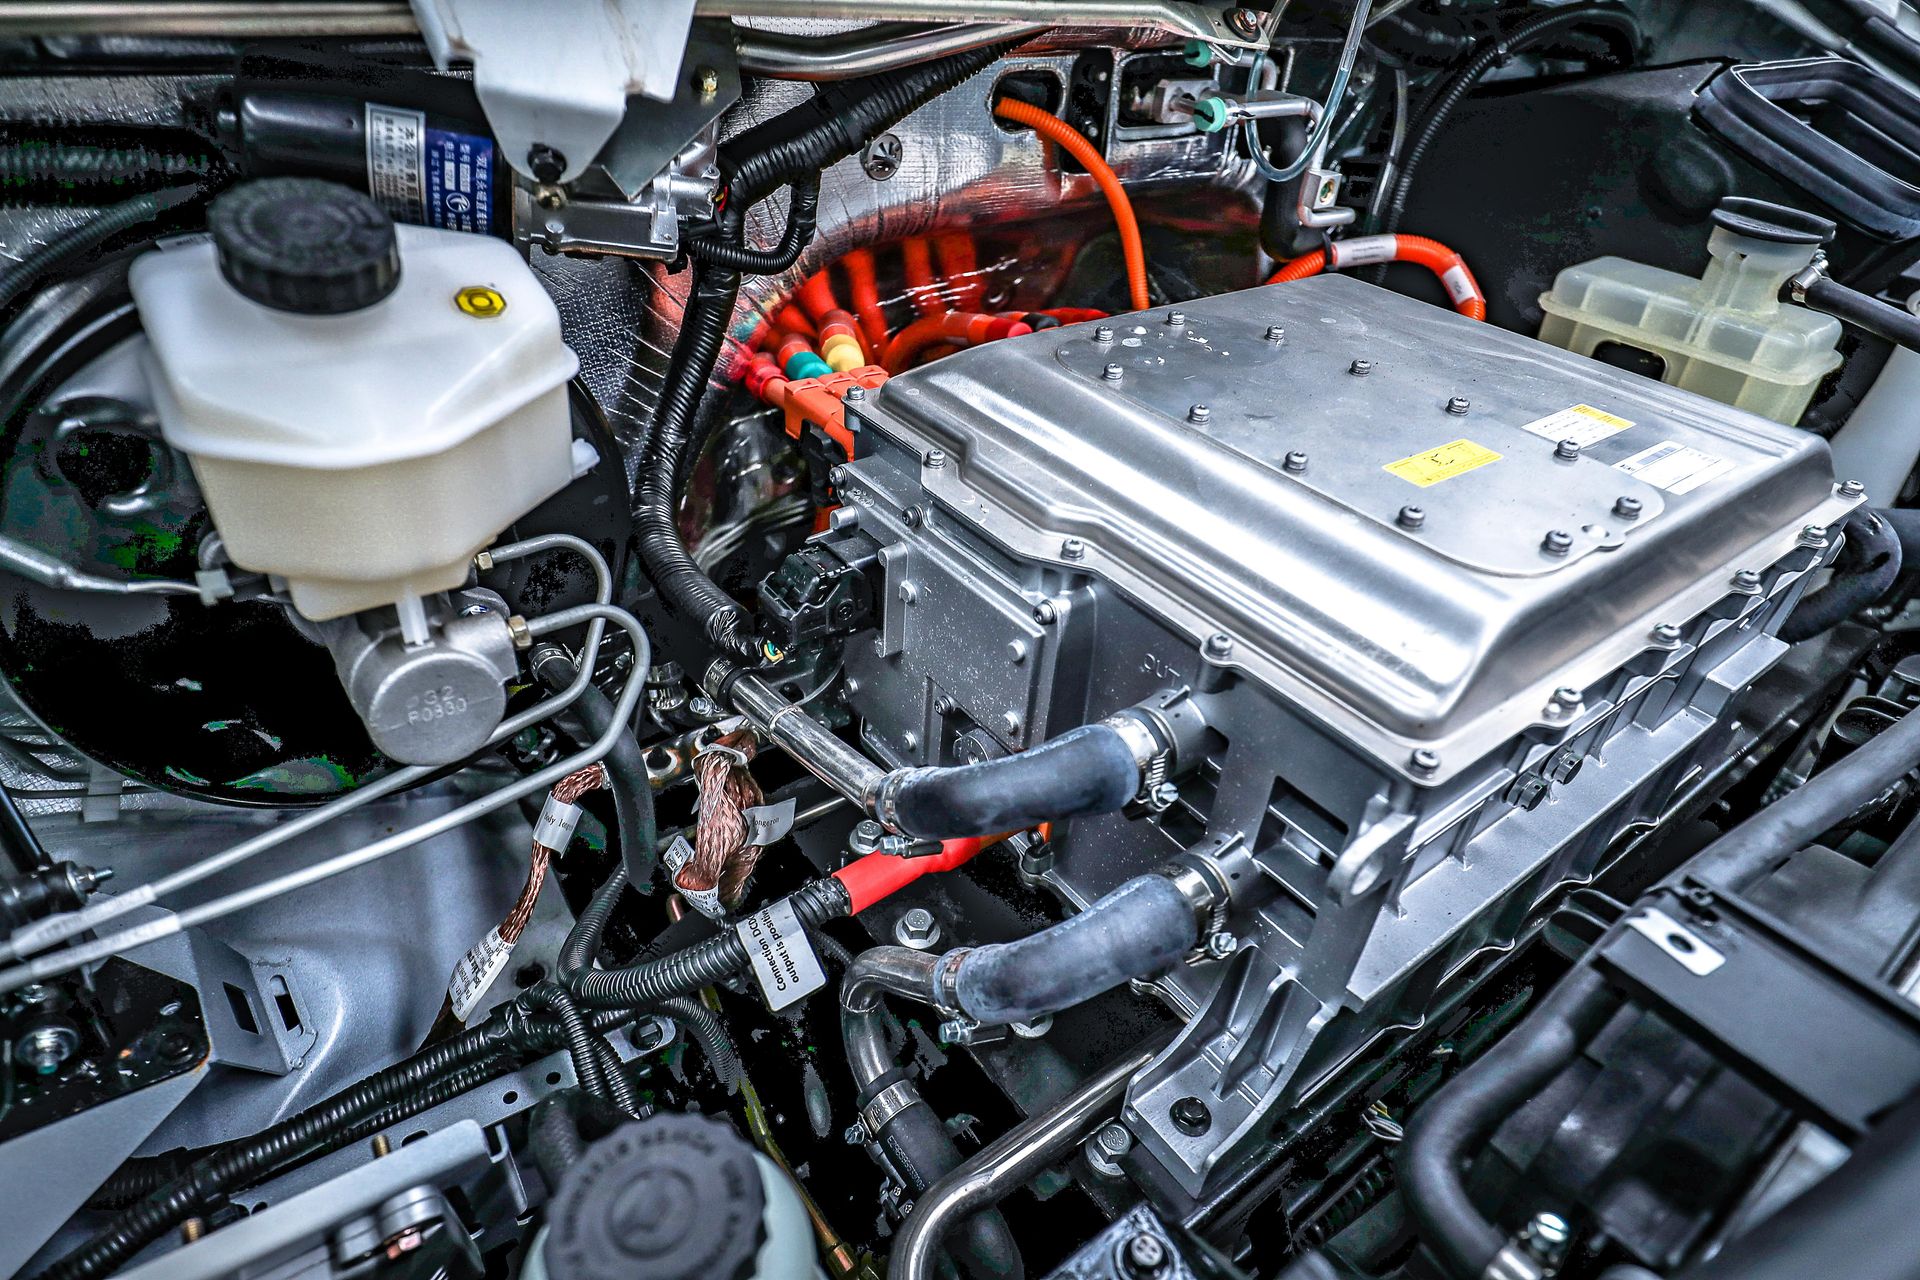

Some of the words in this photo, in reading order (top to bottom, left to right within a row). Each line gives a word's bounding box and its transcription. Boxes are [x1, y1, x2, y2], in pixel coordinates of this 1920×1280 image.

[1143, 652, 1181, 687] OUT
[775, 941, 784, 952] is
[758, 938, 787, 992] Connection
[779, 950, 800, 984] output
